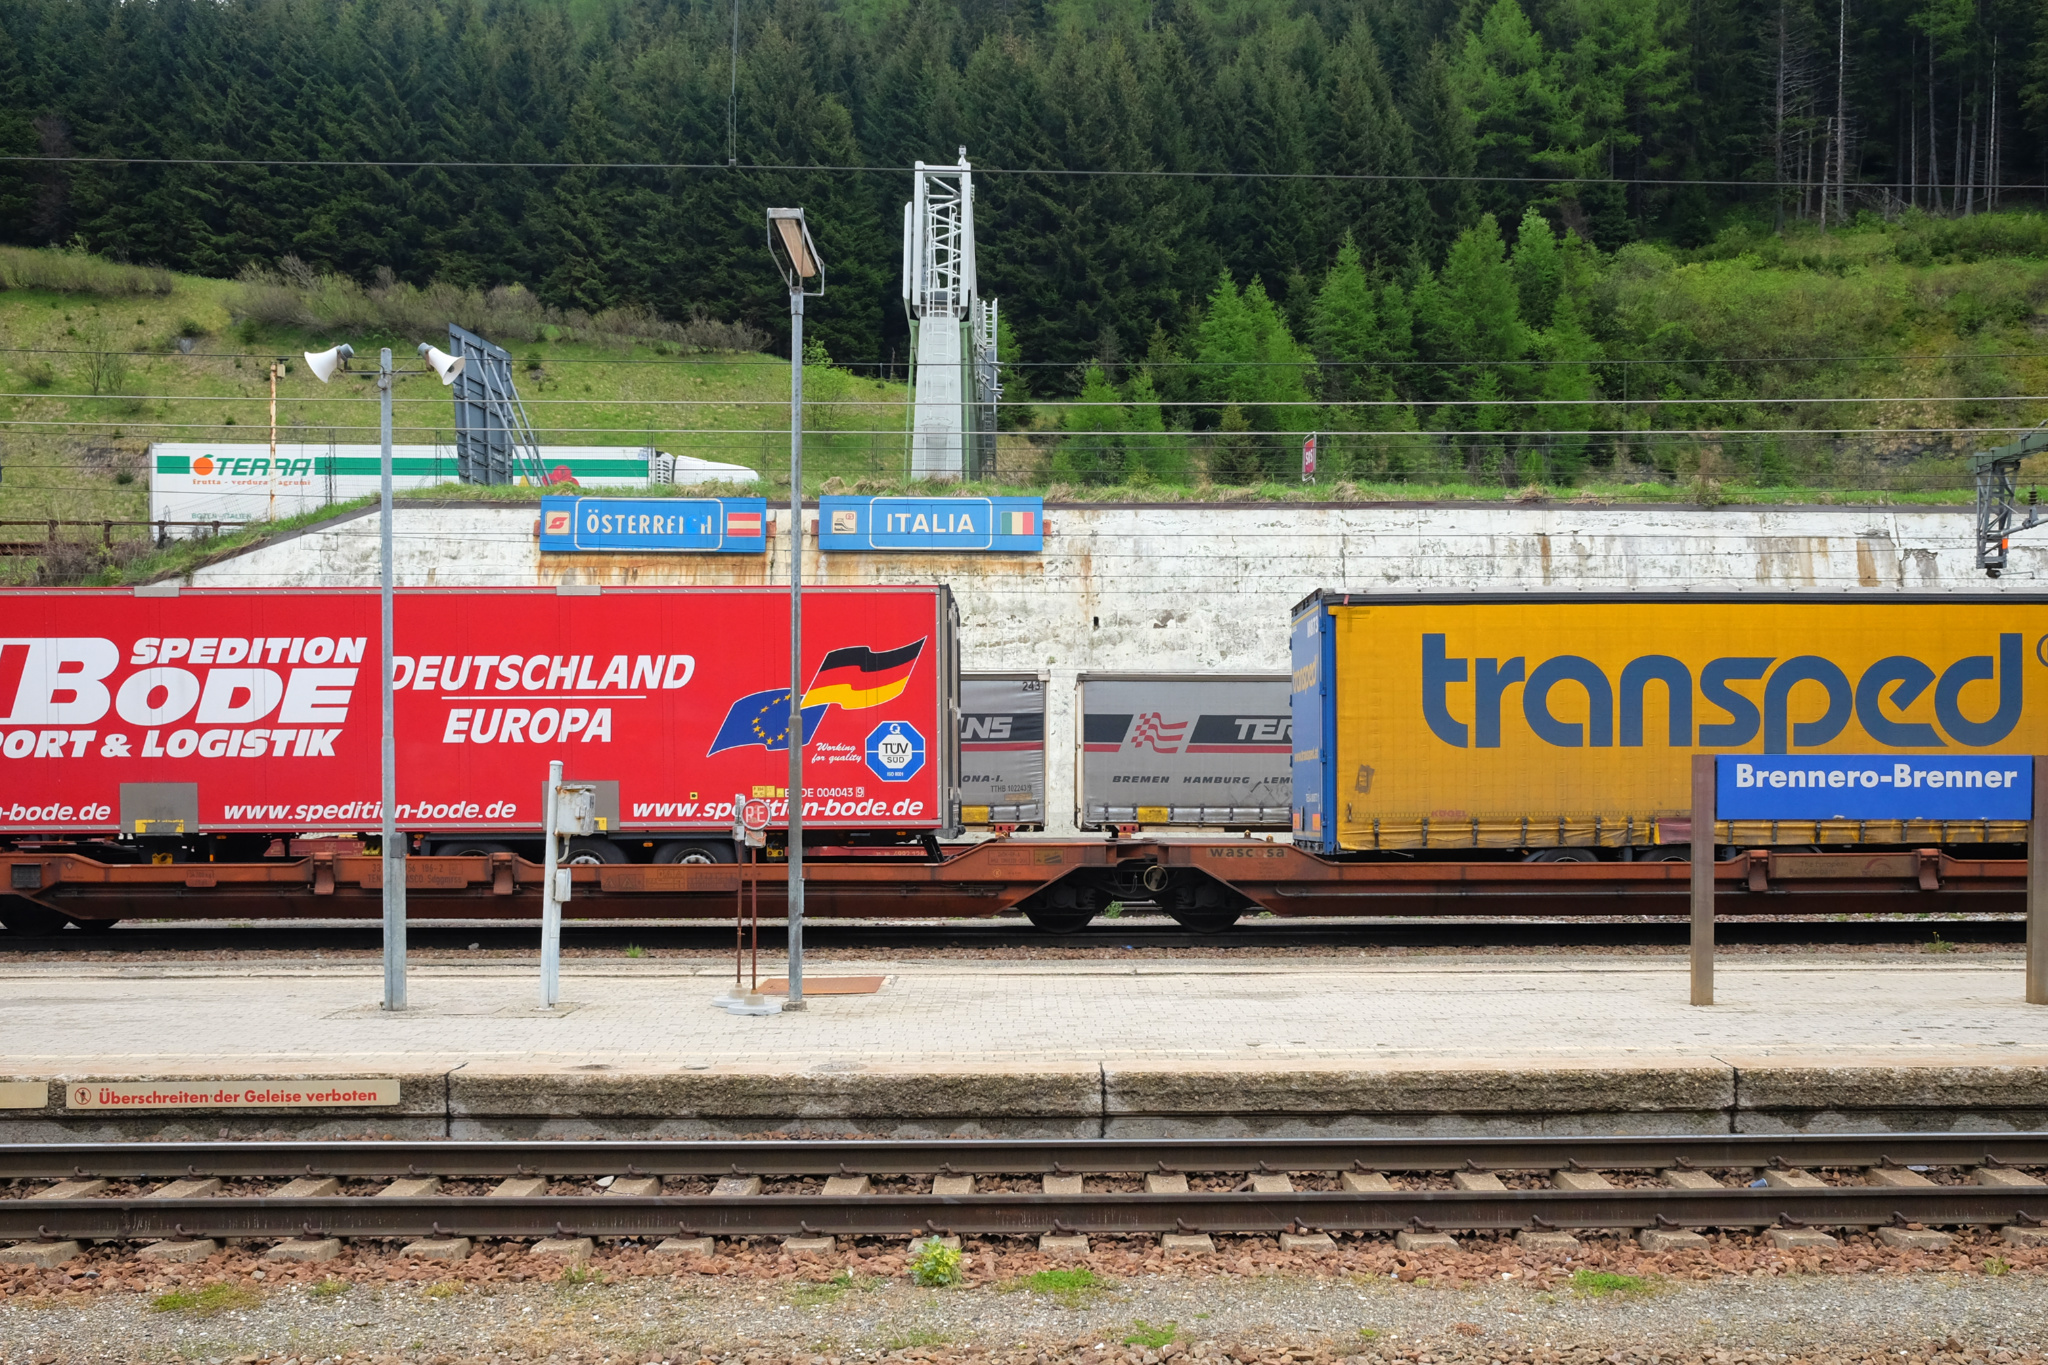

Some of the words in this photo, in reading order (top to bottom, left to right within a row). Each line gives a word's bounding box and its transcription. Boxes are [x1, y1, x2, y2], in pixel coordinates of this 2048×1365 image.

[215, 457, 313, 477] TERRA
[192, 478, 221, 486] frutta
[231, 478, 269, 486] verdura
[278, 478, 312, 487] agrumi
[586, 508, 712, 534] ÖSTERREIH
[886, 512, 975, 534] ITALIA
[130, 637, 367, 664] SPEDITION
[8, 637, 359, 726] BODE
[393, 655, 695, 690] DEUTSCHLAND
[1022, 681, 1041, 691] 243
[1422, 633, 2023, 755] transped
[442, 708, 612, 743] EUROPA
[0, 728, 97, 759] ORT
[100, 733, 132, 758] &
[141, 728, 343, 758] LOGISTIK
[815, 741, 856, 752] Working
[882, 742, 909, 754] TÜV
[811, 754, 826, 764] for
[828, 753, 862, 764] quality
[886, 756, 905, 764] SÜD
[1112, 775, 1170, 784] BREMEN
[1183, 776, 1250, 784] HAMBURG
[1264, 776, 1292, 784] LEM
[1736, 762, 2017, 789] Brennero-Brenner
[816, 787, 854, 798] 004043
[856, 786, 865, 798] 9
[0, 802, 111, 821] -bode.de
[224, 801, 517, 822] www.speditin-bode.de
[99, 1087, 209, 1105] Überschreiten
[214, 1089, 243, 1103] der
[244, 1089, 302, 1104] Geleise
[305, 1088, 378, 1102] verboten
